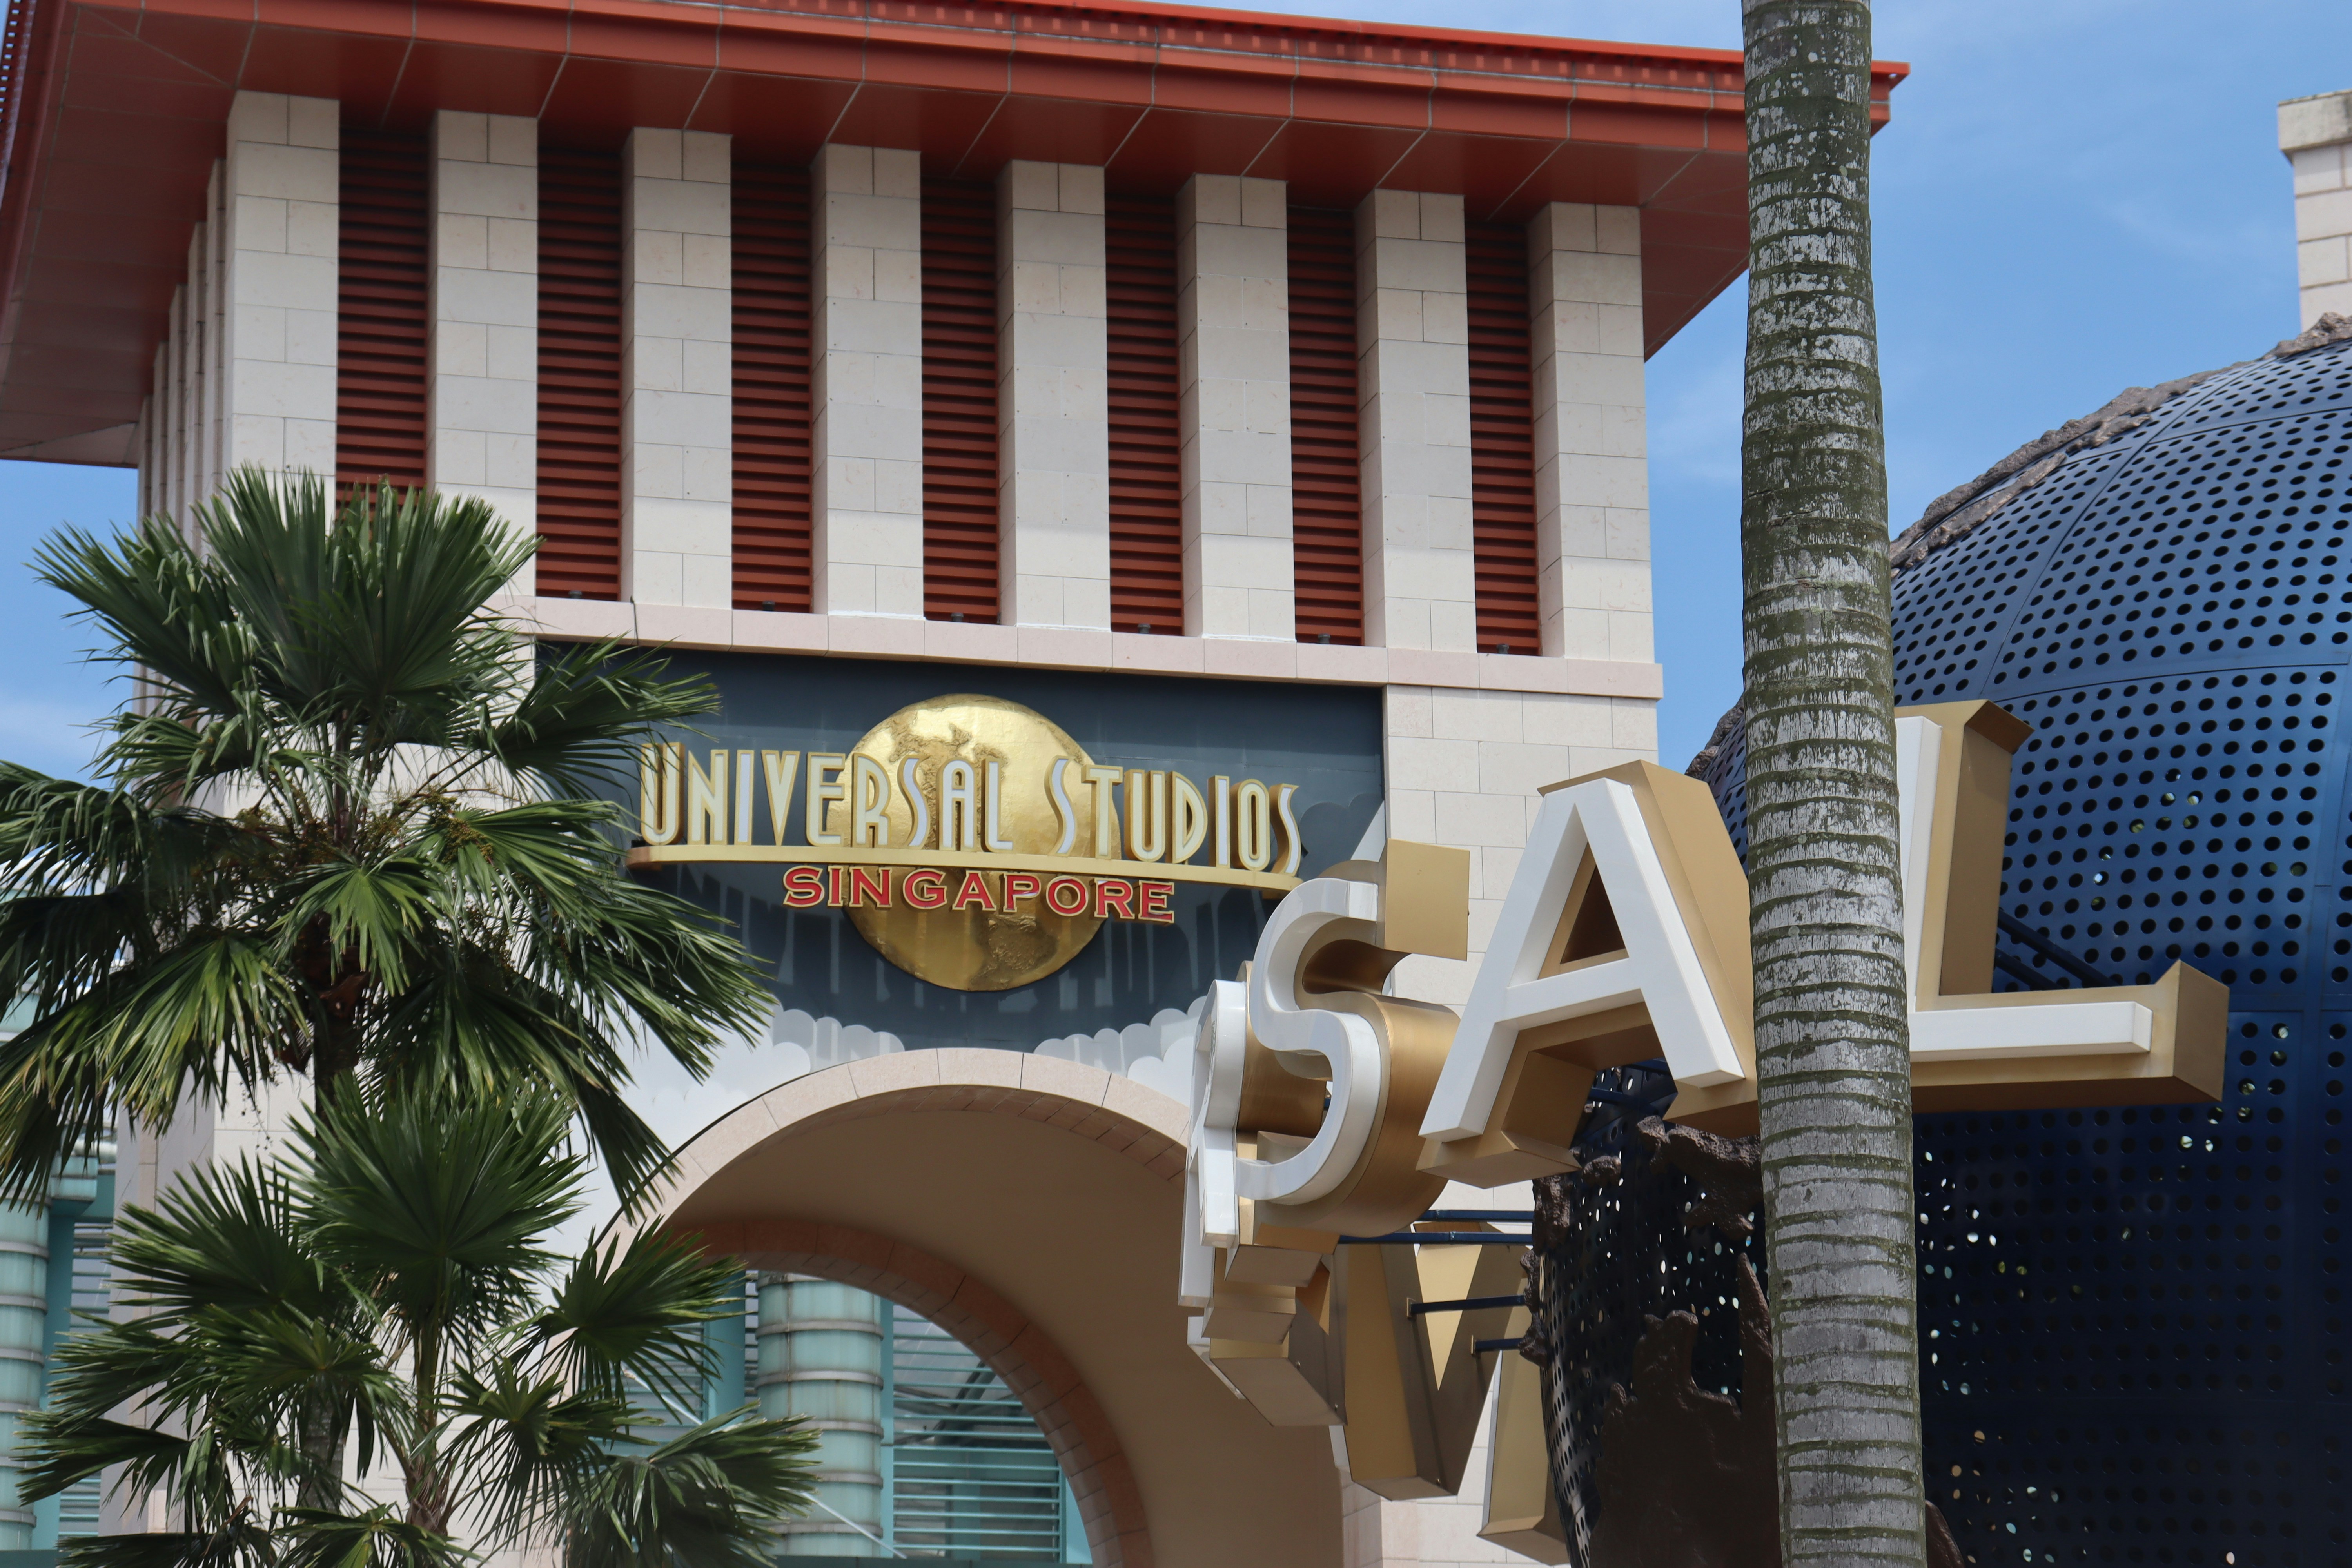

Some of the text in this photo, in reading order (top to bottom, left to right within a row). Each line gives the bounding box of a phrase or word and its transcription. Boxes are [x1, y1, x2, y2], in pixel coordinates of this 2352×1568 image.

[640, 742, 1299, 877] UNIVERSAL STUDIOS
[783, 865, 1175, 924] SINGAPORE
